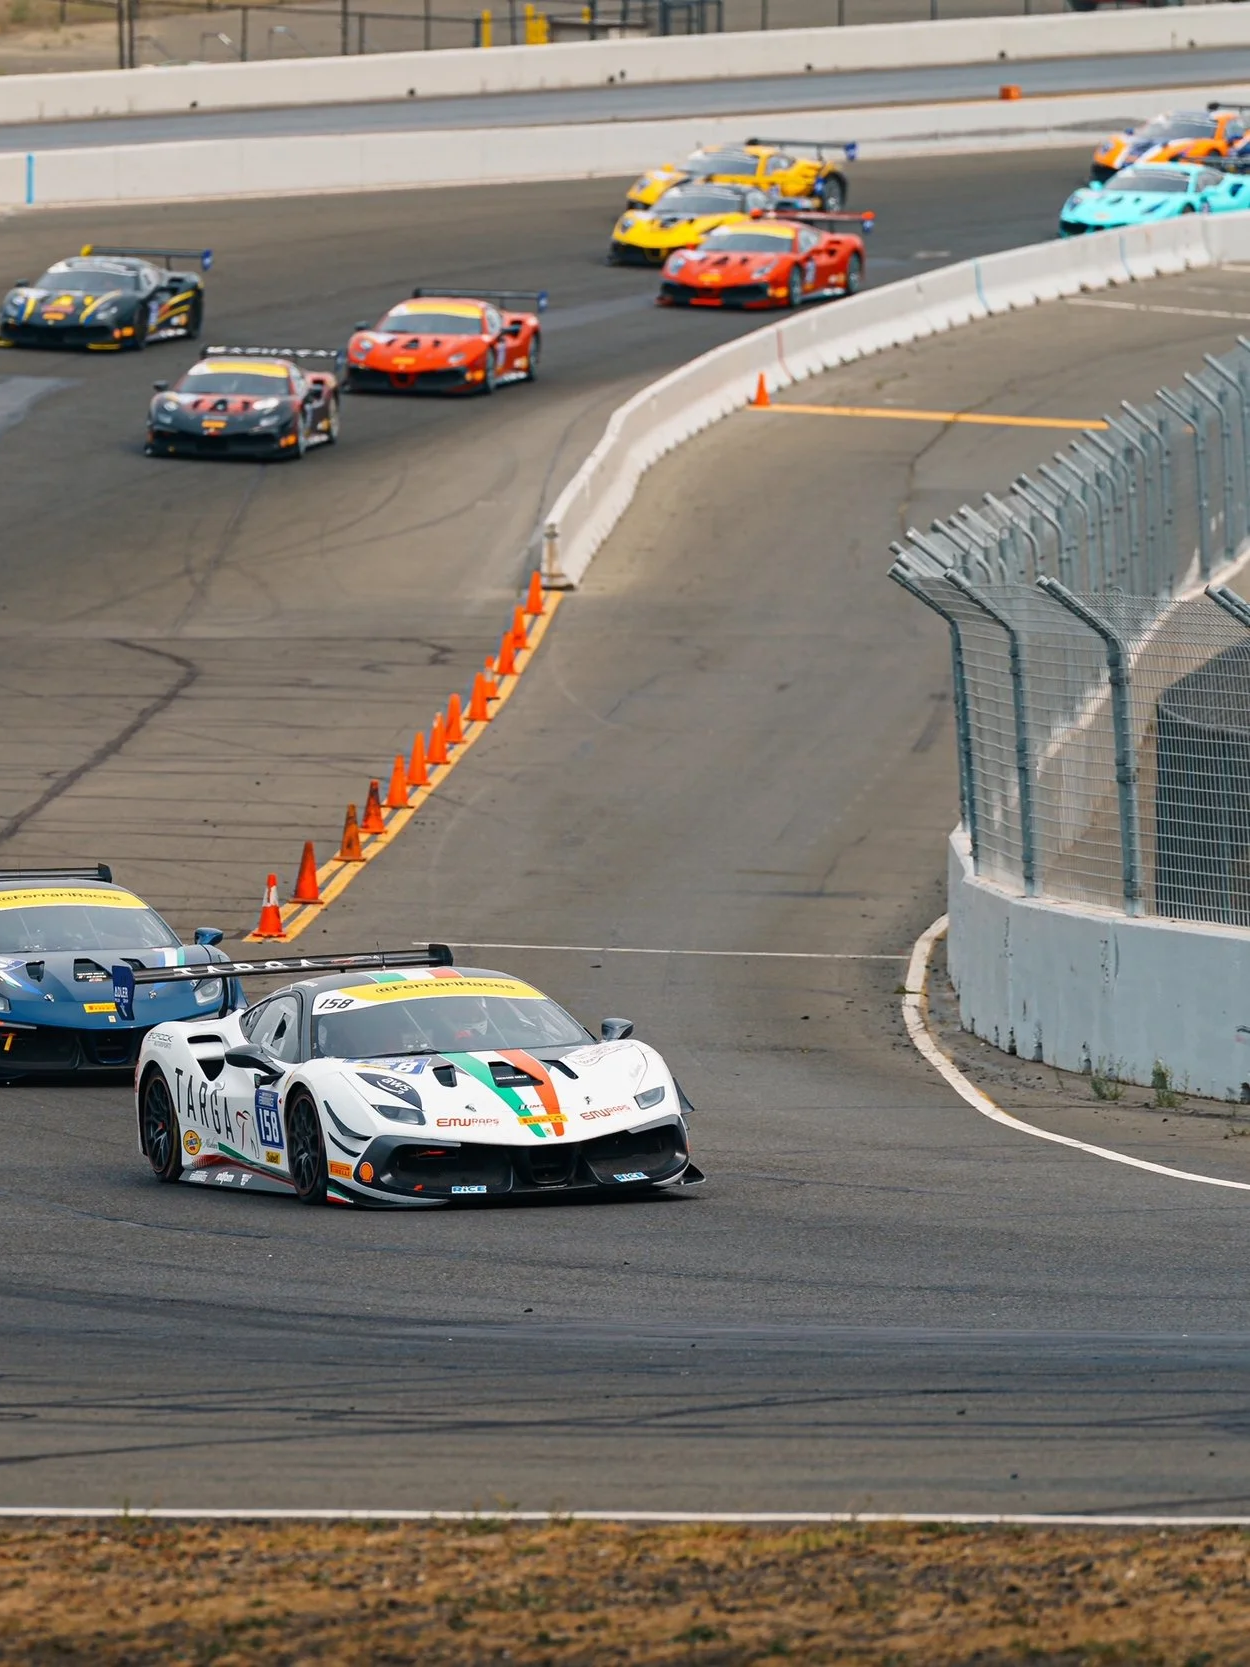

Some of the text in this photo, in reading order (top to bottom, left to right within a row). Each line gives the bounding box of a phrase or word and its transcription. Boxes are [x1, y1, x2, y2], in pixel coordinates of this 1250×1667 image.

[374, 980, 516, 995] @FerrariRaces
[318, 998, 354, 1010] 158
[381, 1077, 413, 1092] aws
[175, 1067, 235, 1143] TARGA
[259, 1107, 280, 1144] 158
